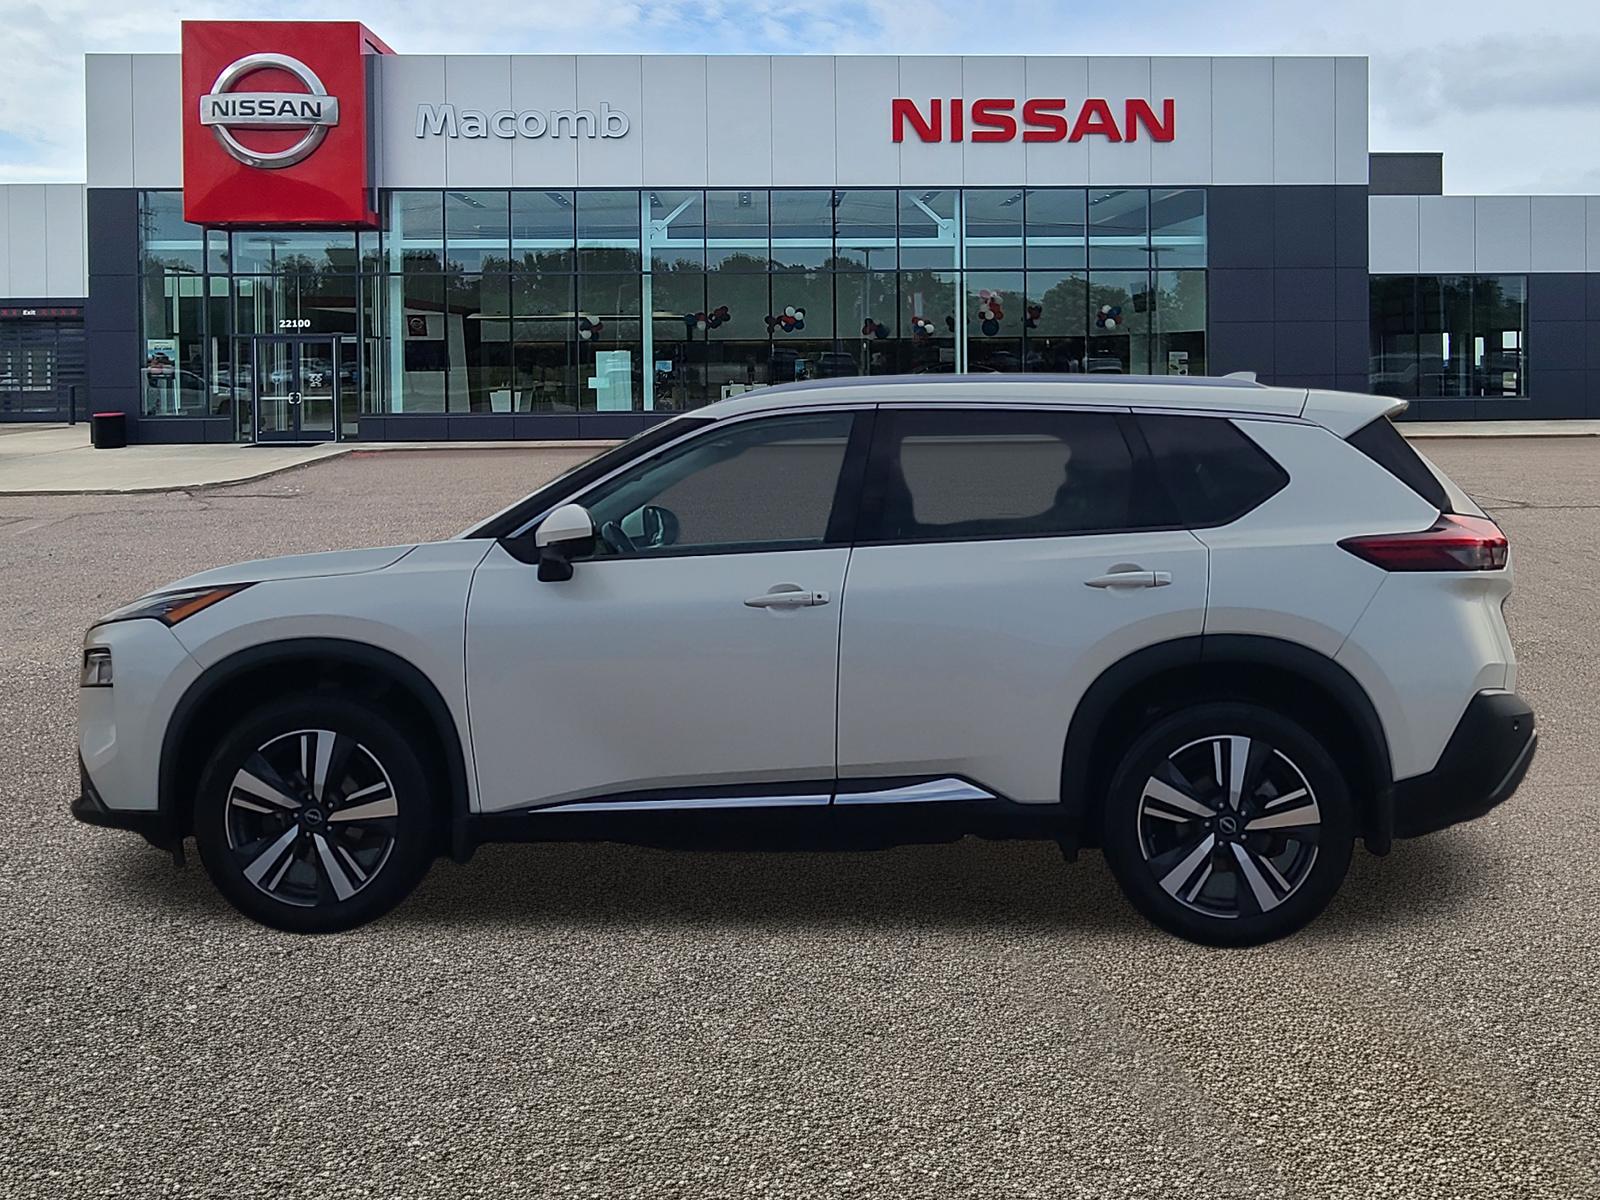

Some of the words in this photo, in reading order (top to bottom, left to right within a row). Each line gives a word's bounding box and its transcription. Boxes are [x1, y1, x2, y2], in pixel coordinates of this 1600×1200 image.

[211, 100, 322, 118] NISSAN
[415, 102, 630, 139] Macomb
[892, 98, 1175, 143] NISSAN
[279, 319, 311, 328] 22100
